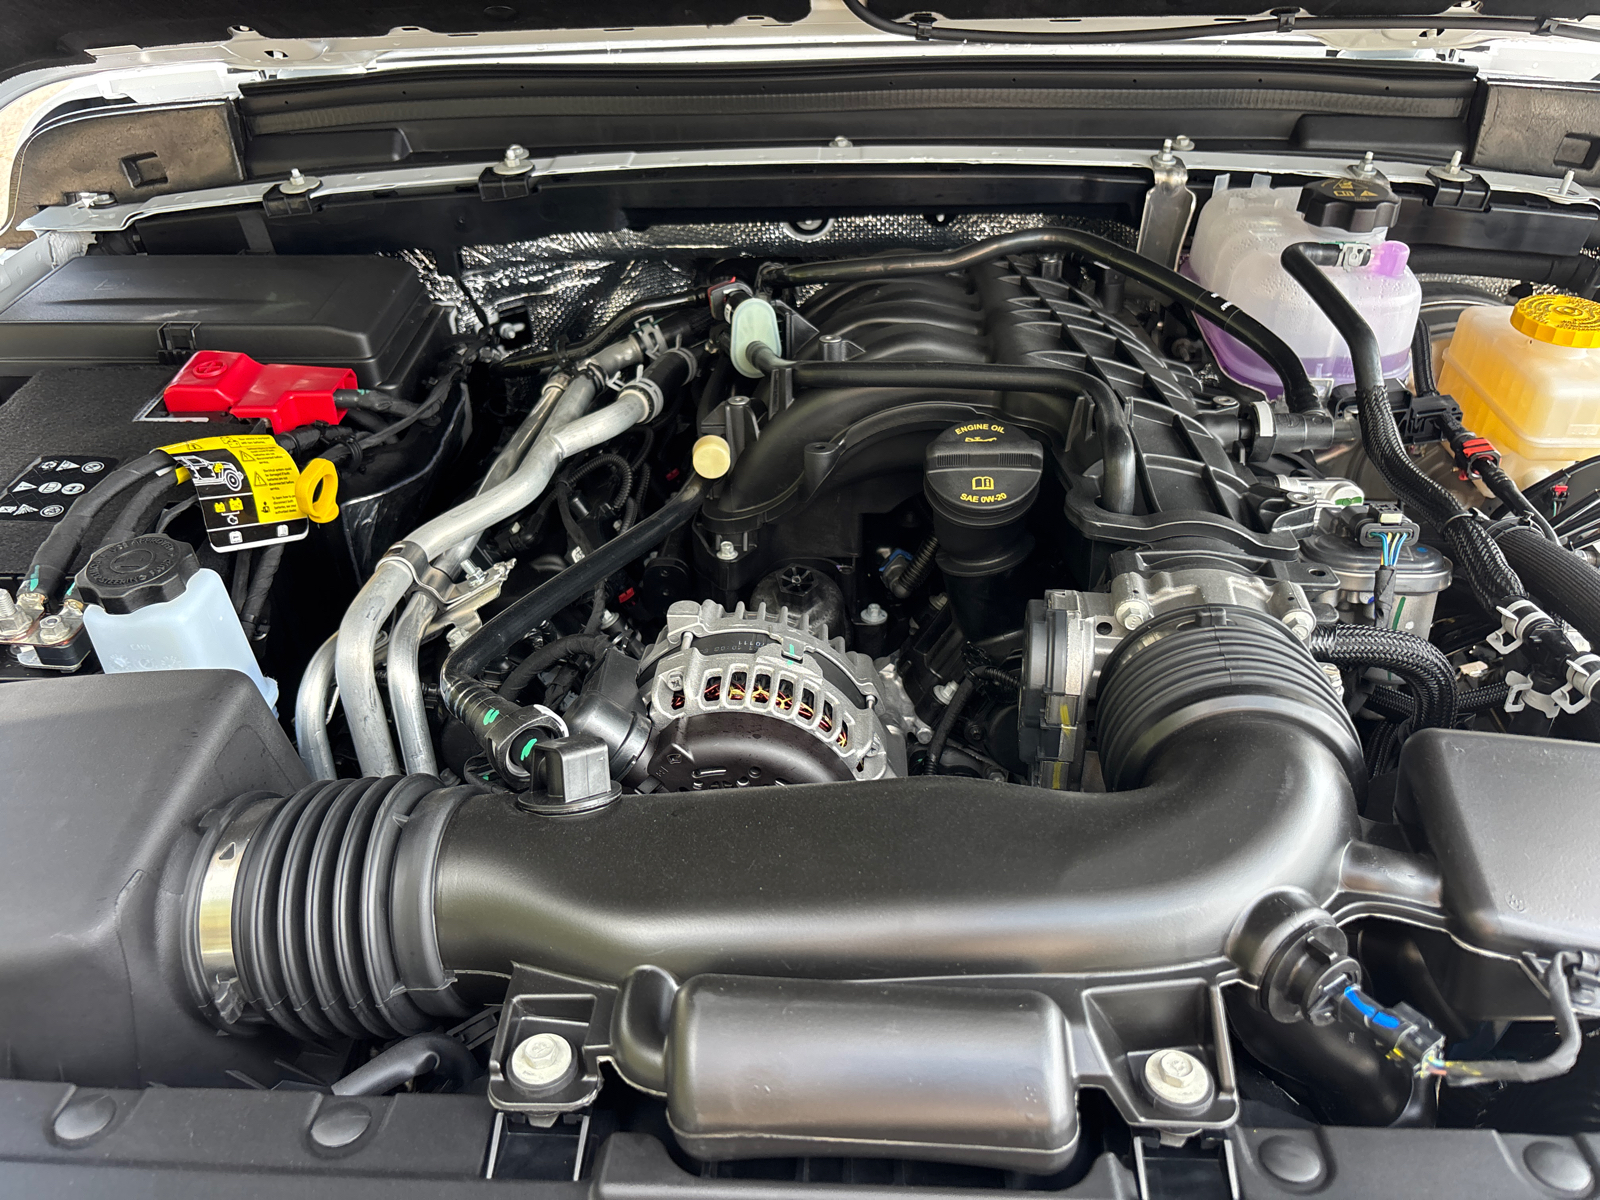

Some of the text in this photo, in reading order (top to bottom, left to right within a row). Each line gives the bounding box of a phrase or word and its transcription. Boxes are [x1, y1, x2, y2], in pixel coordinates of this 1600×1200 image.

[955, 423, 1005, 435] ENGINE OIL
[960, 492, 1007, 503] SAE 0W-20
